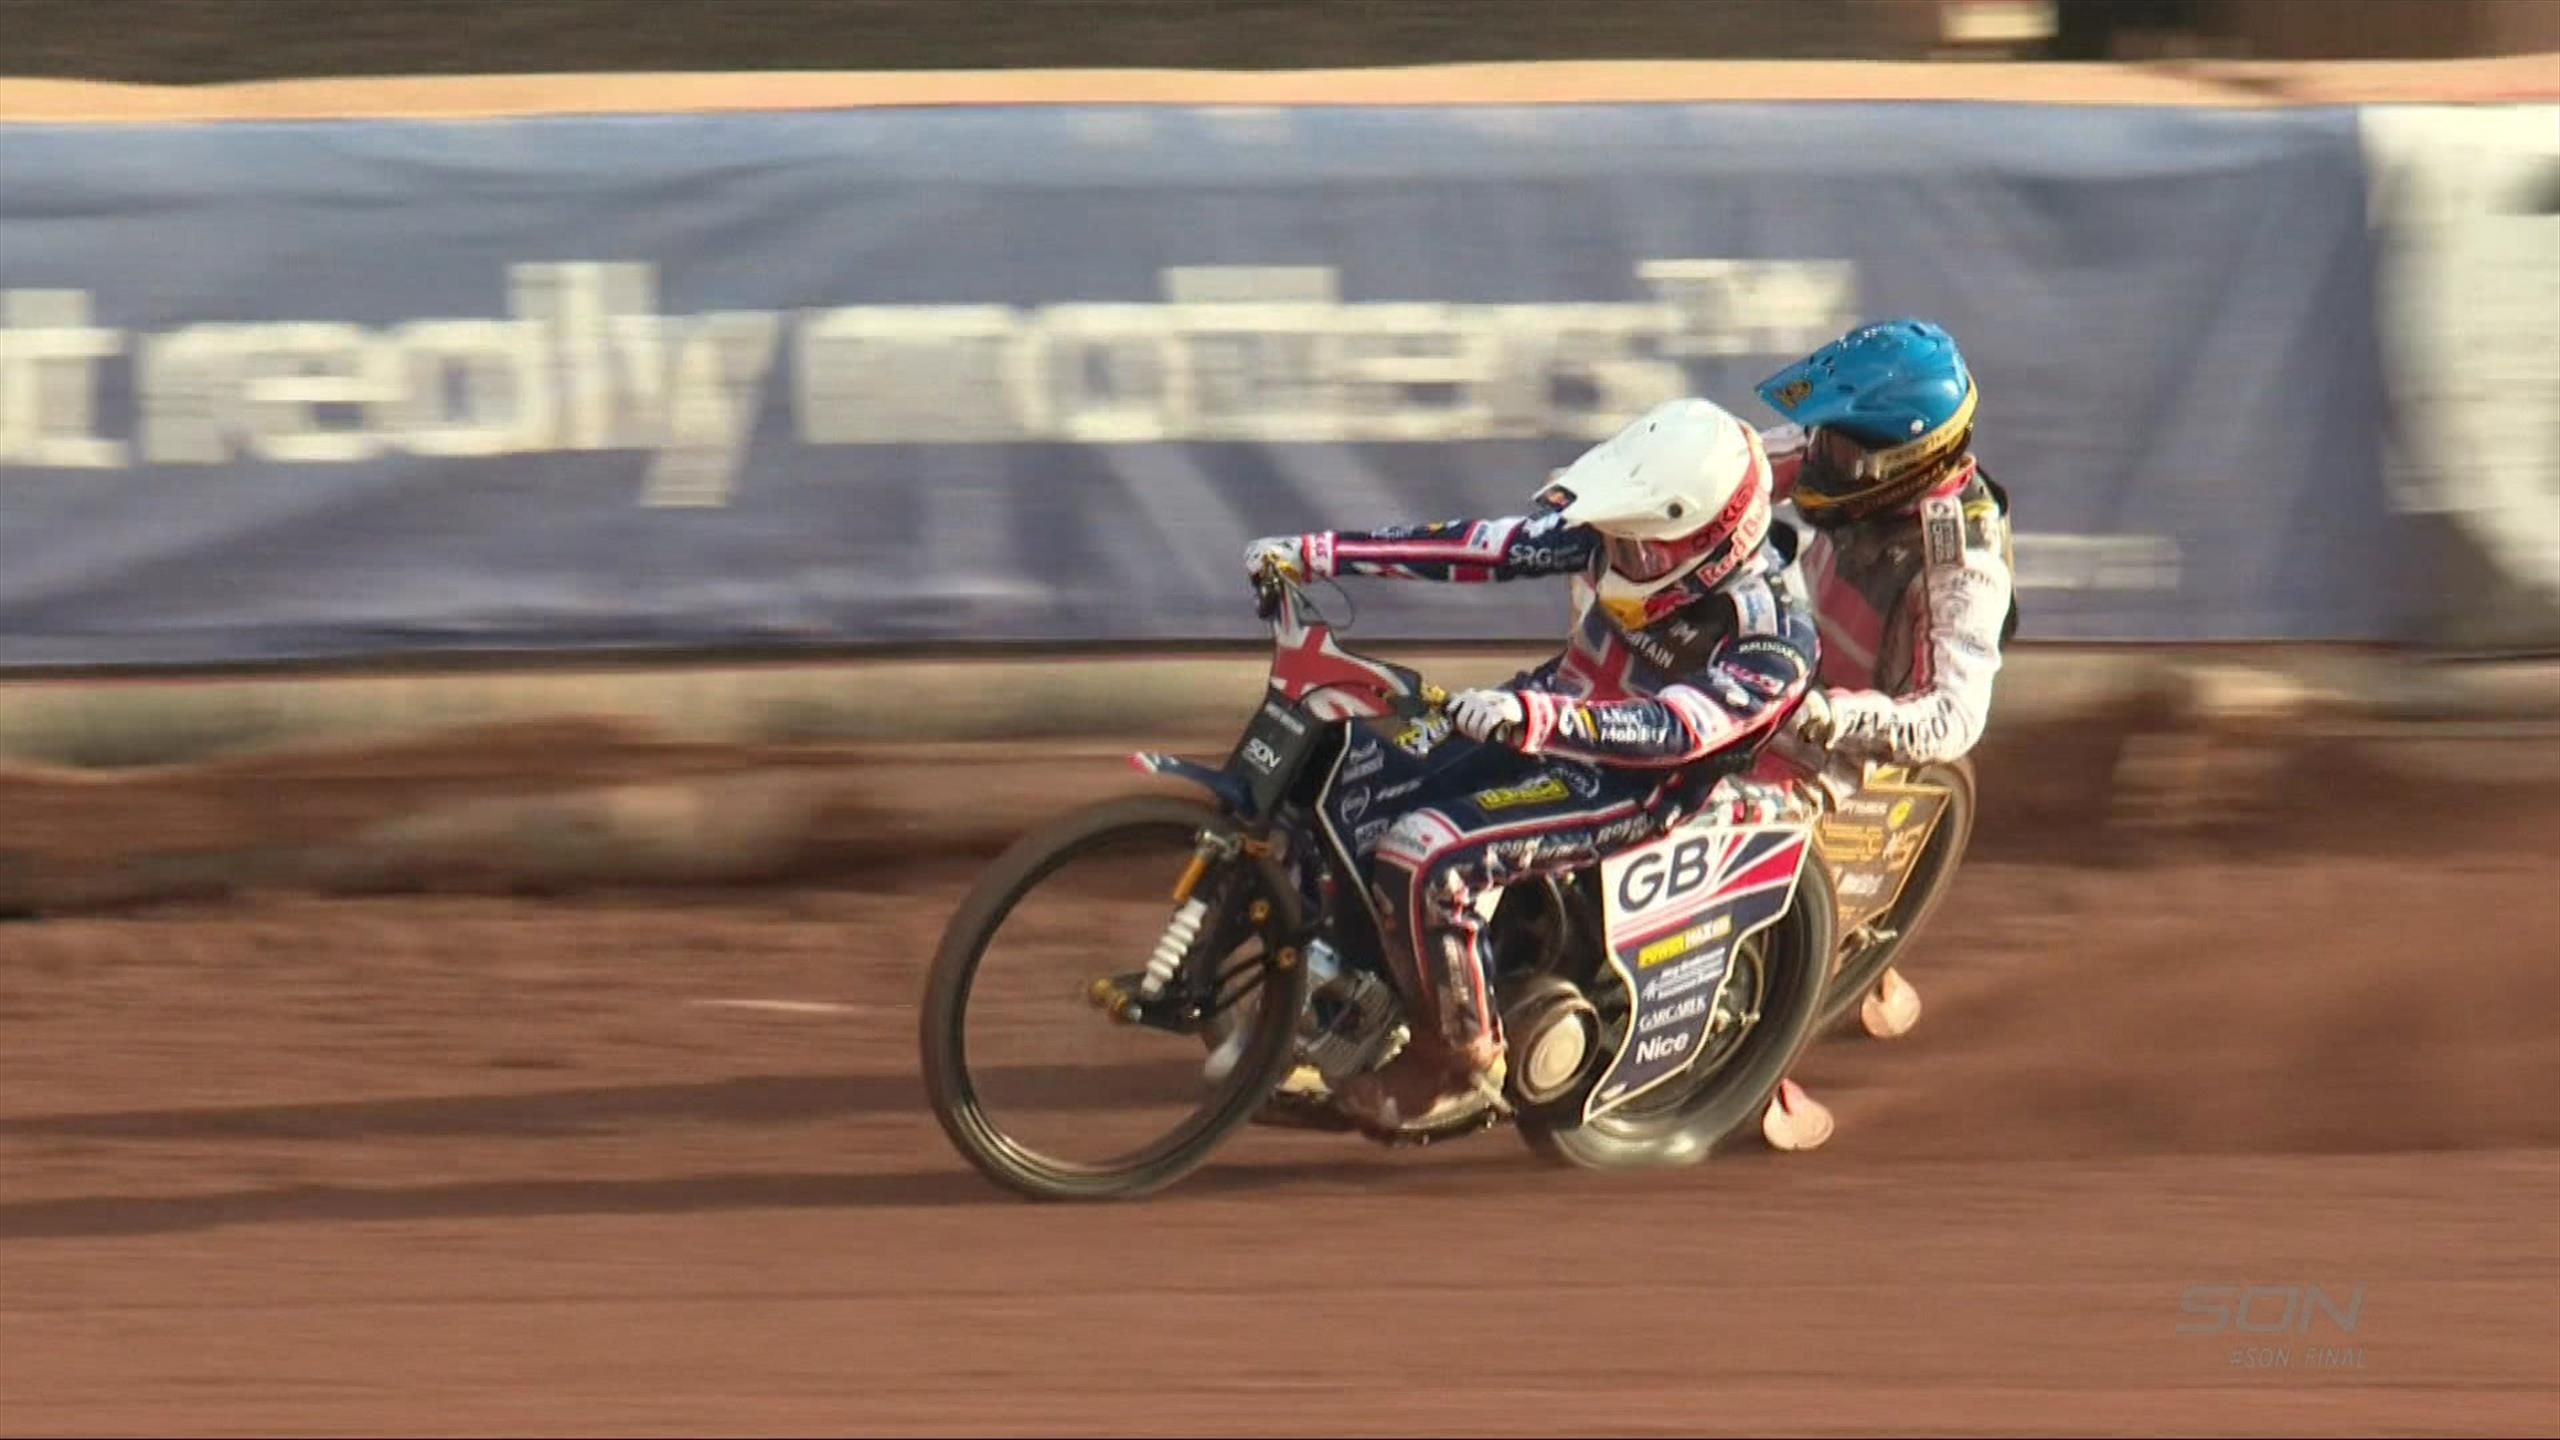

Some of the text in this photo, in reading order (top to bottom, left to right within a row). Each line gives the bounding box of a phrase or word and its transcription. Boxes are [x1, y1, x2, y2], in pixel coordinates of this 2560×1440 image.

[1507, 543, 1552, 567] SRG
[1697, 532, 1746, 588] Red
[1625, 632, 1675, 668] ITAIN
[1618, 834, 1710, 912] GB
[1635, 1031, 1690, 1065] Nice
